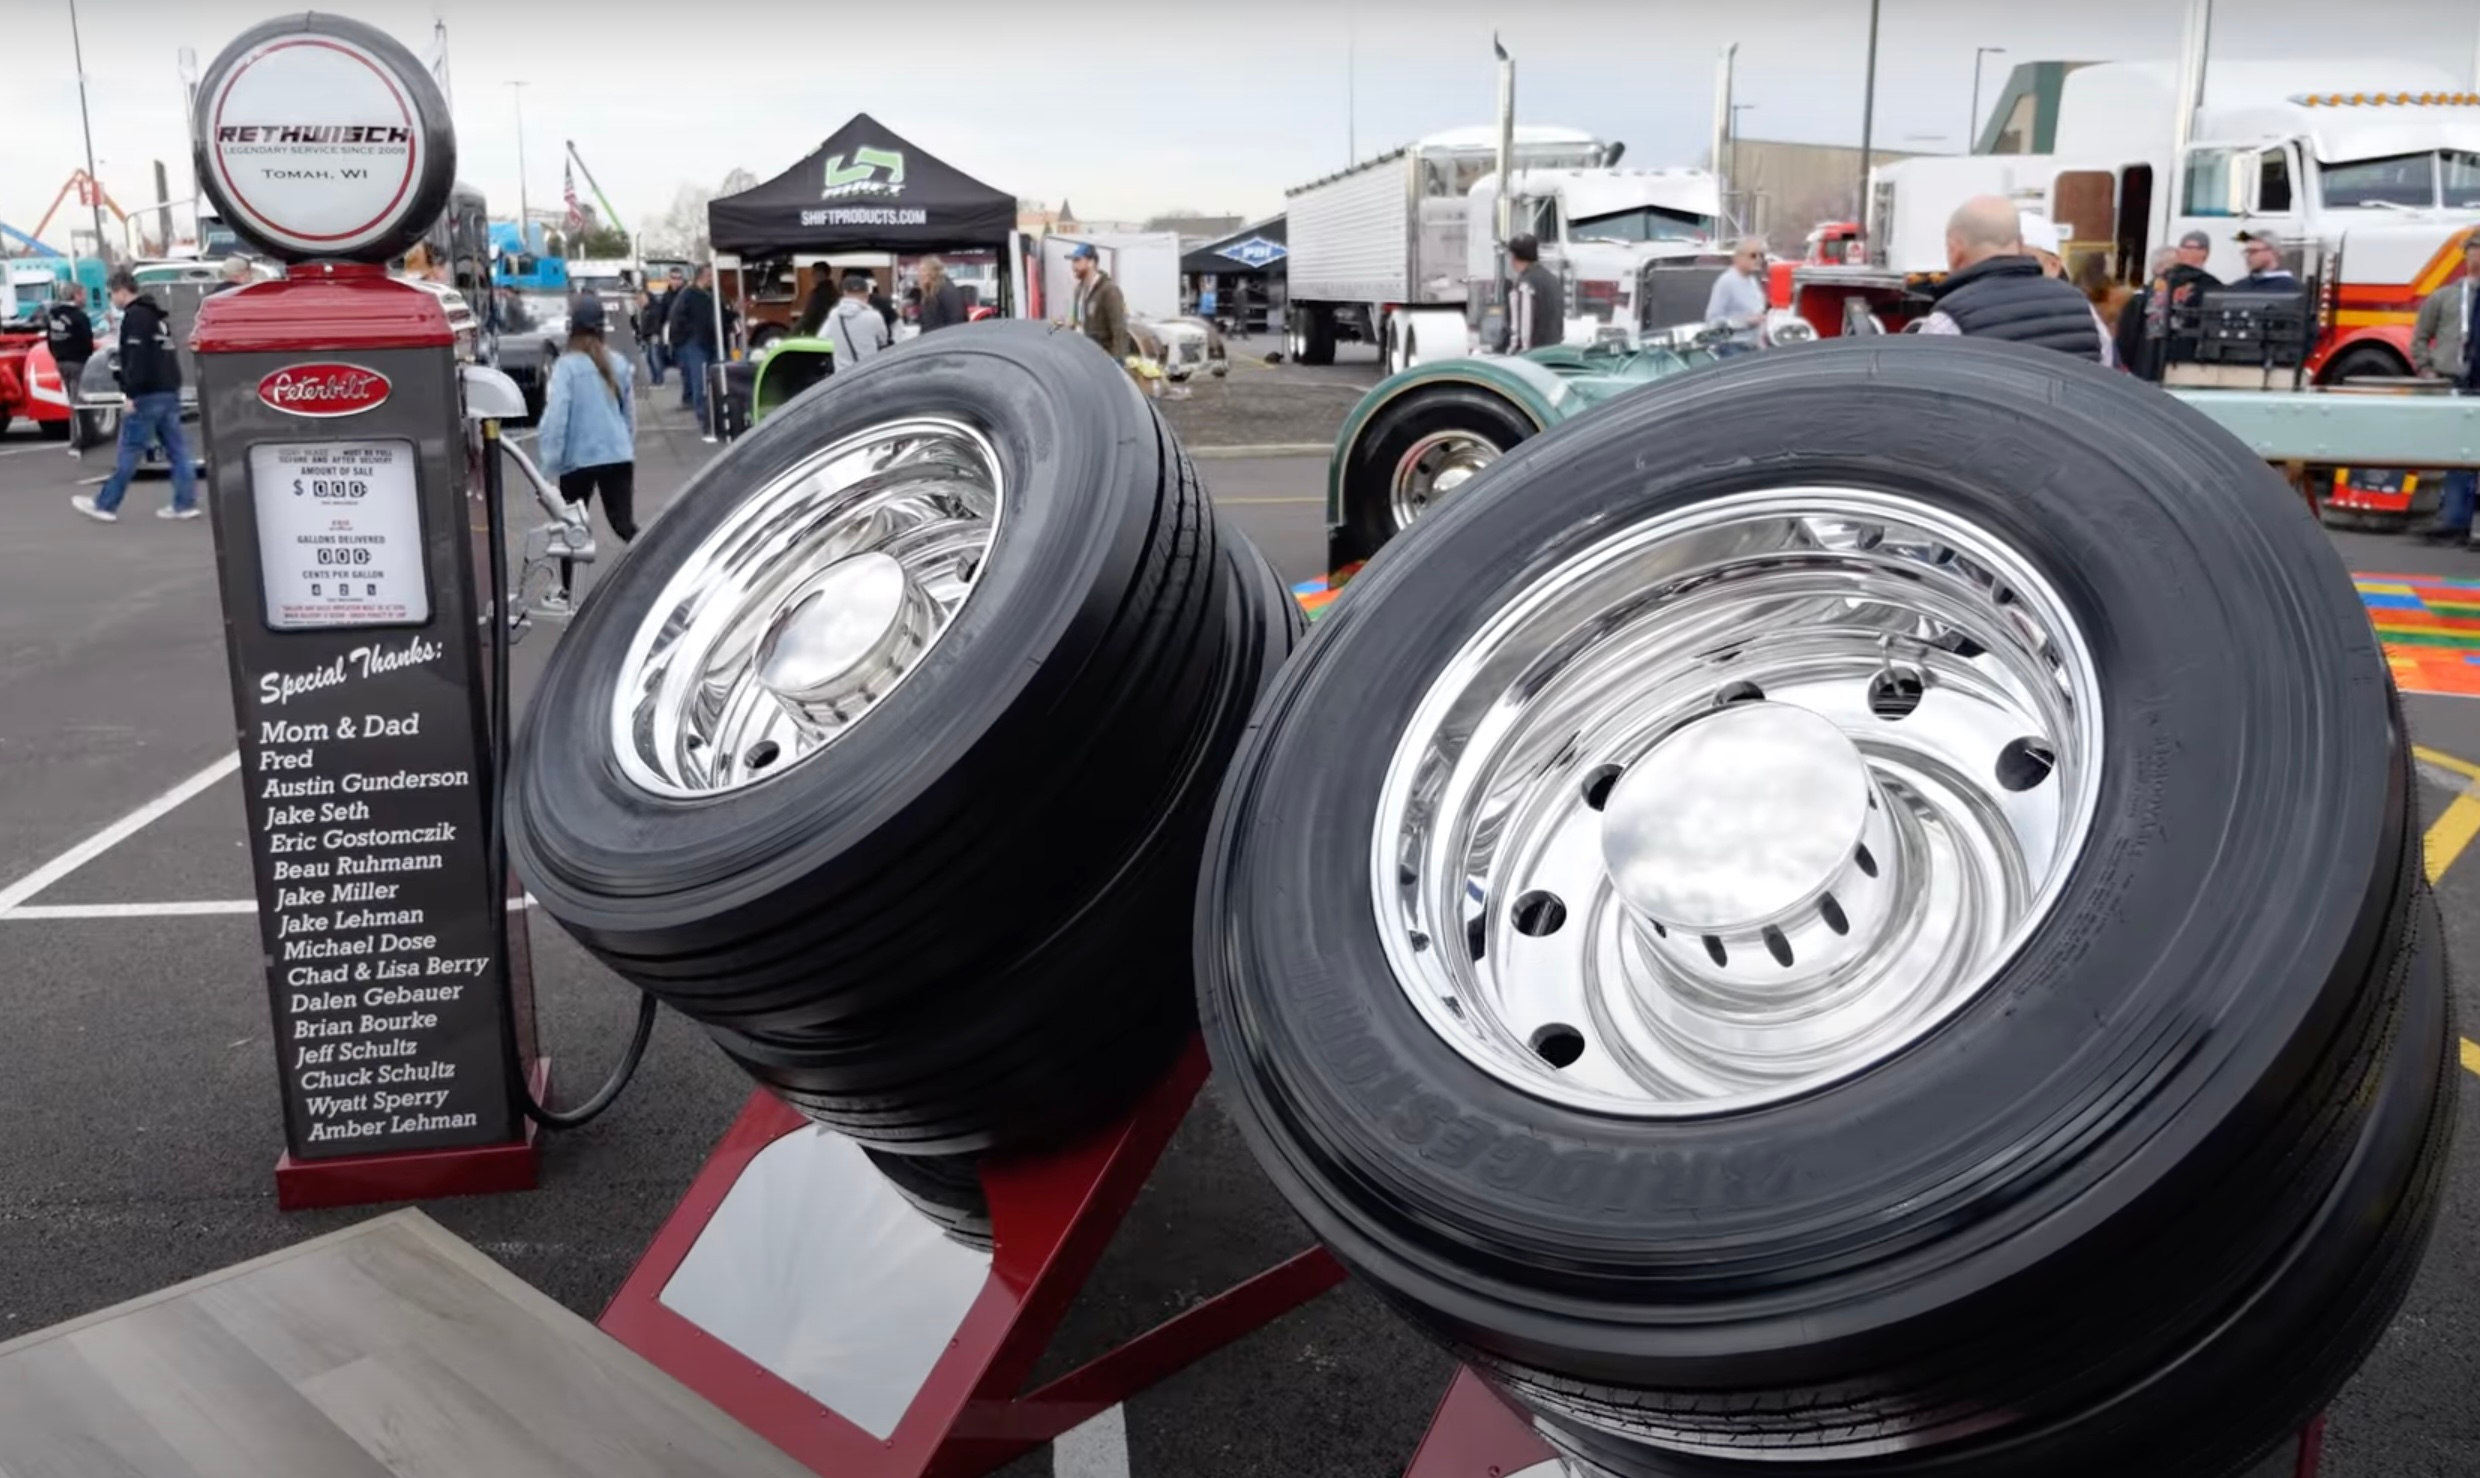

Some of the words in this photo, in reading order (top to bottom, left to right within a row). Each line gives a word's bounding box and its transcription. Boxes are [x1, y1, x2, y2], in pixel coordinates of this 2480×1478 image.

[218, 126, 411, 143] RETHWISCH
[224, 146, 288, 155] LEGENDARY
[291, 146, 340, 155] SERVICE
[342, 146, 374, 155] SINCE
[377, 146, 406, 155] 2009
[341, 169, 368, 180] WI
[801, 207, 926, 226] SHIFTPRODUCTS.COM
[272, 373, 378, 403] Peterbilt
[301, 466, 337, 477] AMOUNT
[339, 466, 351, 477] OF
[353, 466, 374, 477] SALE
[312, 456, 328, 464] AND
[332, 456, 356, 464] AFTER
[360, 456, 393, 465] DELIVERY
[293, 479, 304, 497] $
[297, 535, 336, 545] GALLONS
[338, 535, 386, 545] DELIVERED
[302, 570, 330, 579] CENTS
[332, 570, 350, 579] PER
[352, 570, 384, 579] GALLON
[260, 656, 347, 704] Special
[350, 635, 443, 679] Thanks:
[259, 720, 329, 744] Mom
[336, 716, 357, 739] &
[363, 713, 420, 738] Dad
[259, 749, 314, 771] Fred
[262, 776, 335, 798] Austin
[341, 770, 469, 793] Gunderson
[264, 806, 315, 830] Jake
[320, 801, 370, 822] Seth
[270, 832, 317, 853] Eric
[323, 822, 457, 849] Gostomczik
[273, 861, 330, 880] Beau
[336, 854, 443, 876] Ruhmann
[274, 887, 325, 912] Jake
[331, 882, 400, 903] Miller
[278, 914, 329, 939] Jake
[334, 908, 424, 930] Lehman
[283, 936, 374, 961] Michael
[379, 933, 437, 953] Dose
[287, 964, 349, 986] Chad
[354, 962, 372, 981] &
[376, 960, 420, 979] Lisa
[425, 956, 489, 977] Berry
[290, 992, 357, 1013] Dalen
[364, 985, 464, 1007] Gebauer
[294, 1018, 354, 1039] Brian
[359, 1011, 438, 1033] Bourke
[295, 1044, 335, 1069] Jeff
[339, 1038, 418, 1061] Schultz
[301, 1068, 374, 1090] Chuck
[377, 1061, 456, 1083] Schultz
[306, 1094, 368, 1118] Wyatt
[373, 1089, 449, 1112] Sperry
[308, 1120, 386, 1142] Amber
[390, 1112, 478, 1134] Lehman
